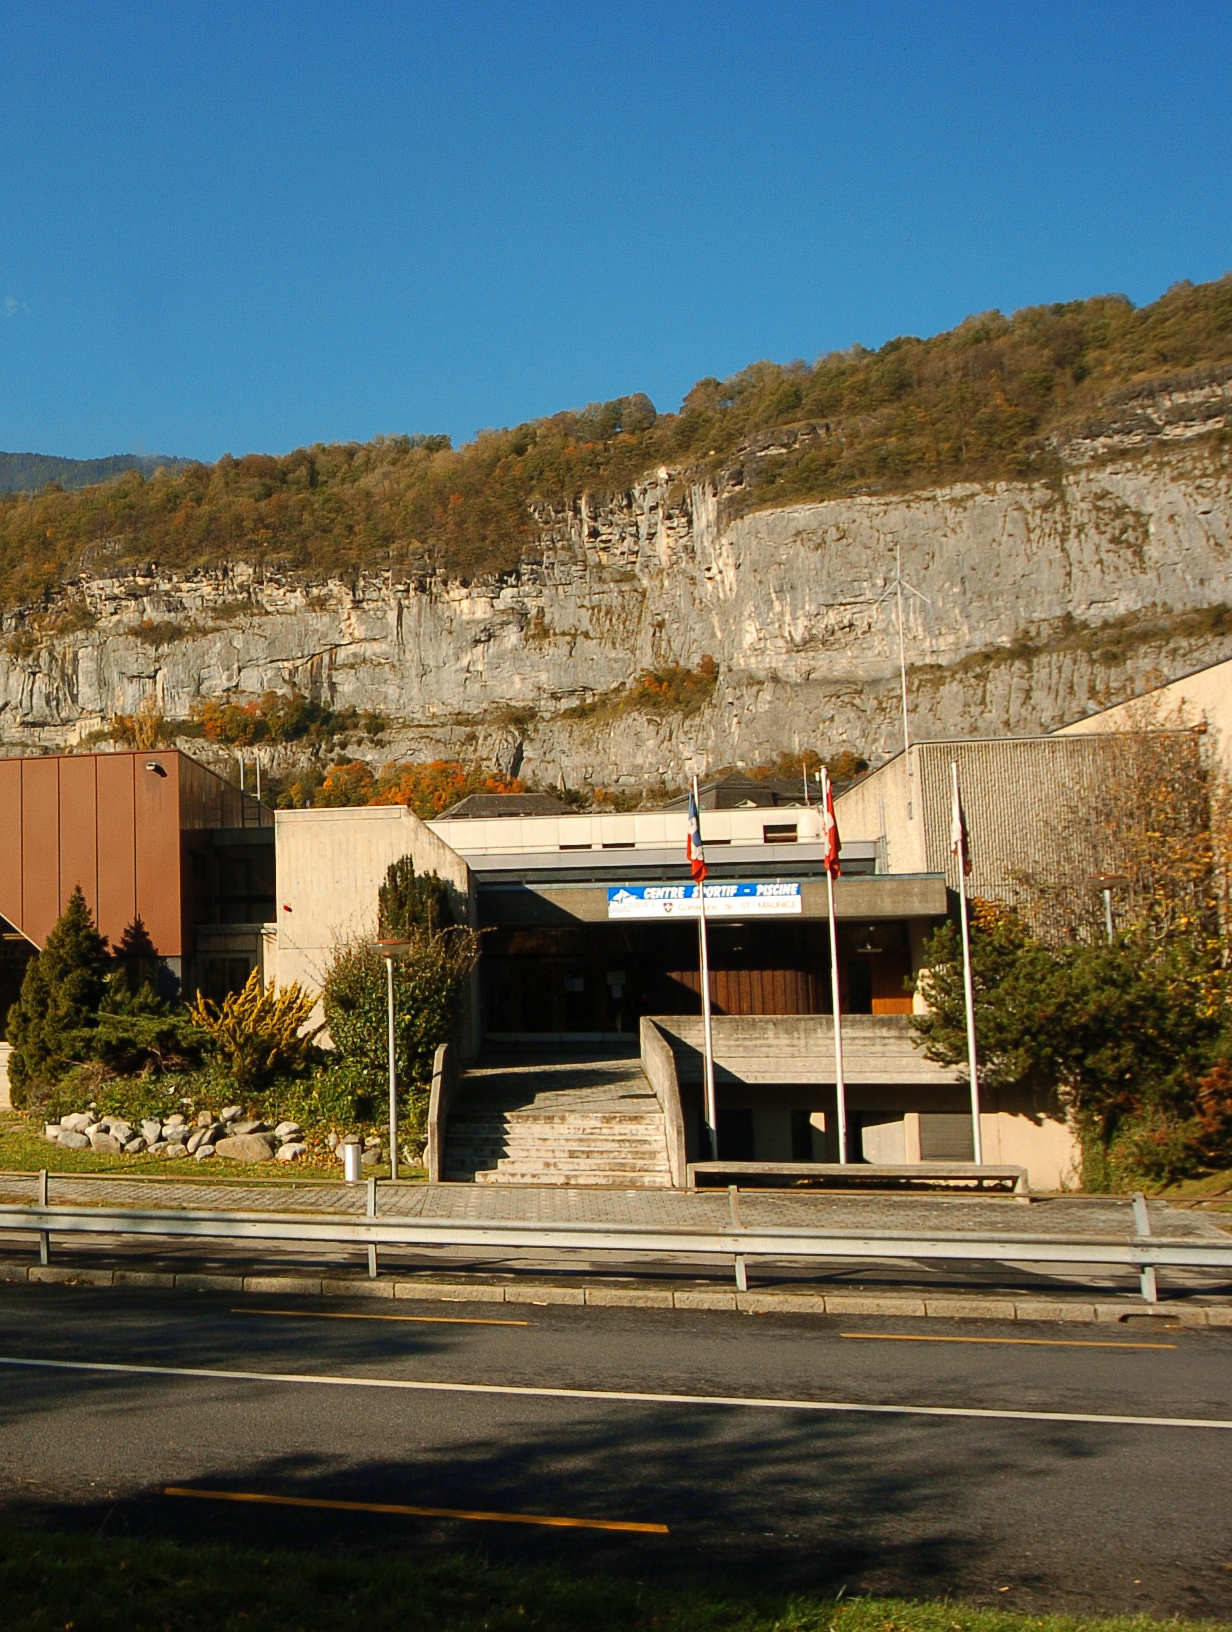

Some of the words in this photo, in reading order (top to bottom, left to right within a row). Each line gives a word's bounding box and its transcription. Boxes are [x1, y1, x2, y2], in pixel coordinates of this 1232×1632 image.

[644, 887, 685, 899] CENTRE
[755, 883, 799, 896] PISCINE
[677, 903, 718, 911] Commne
